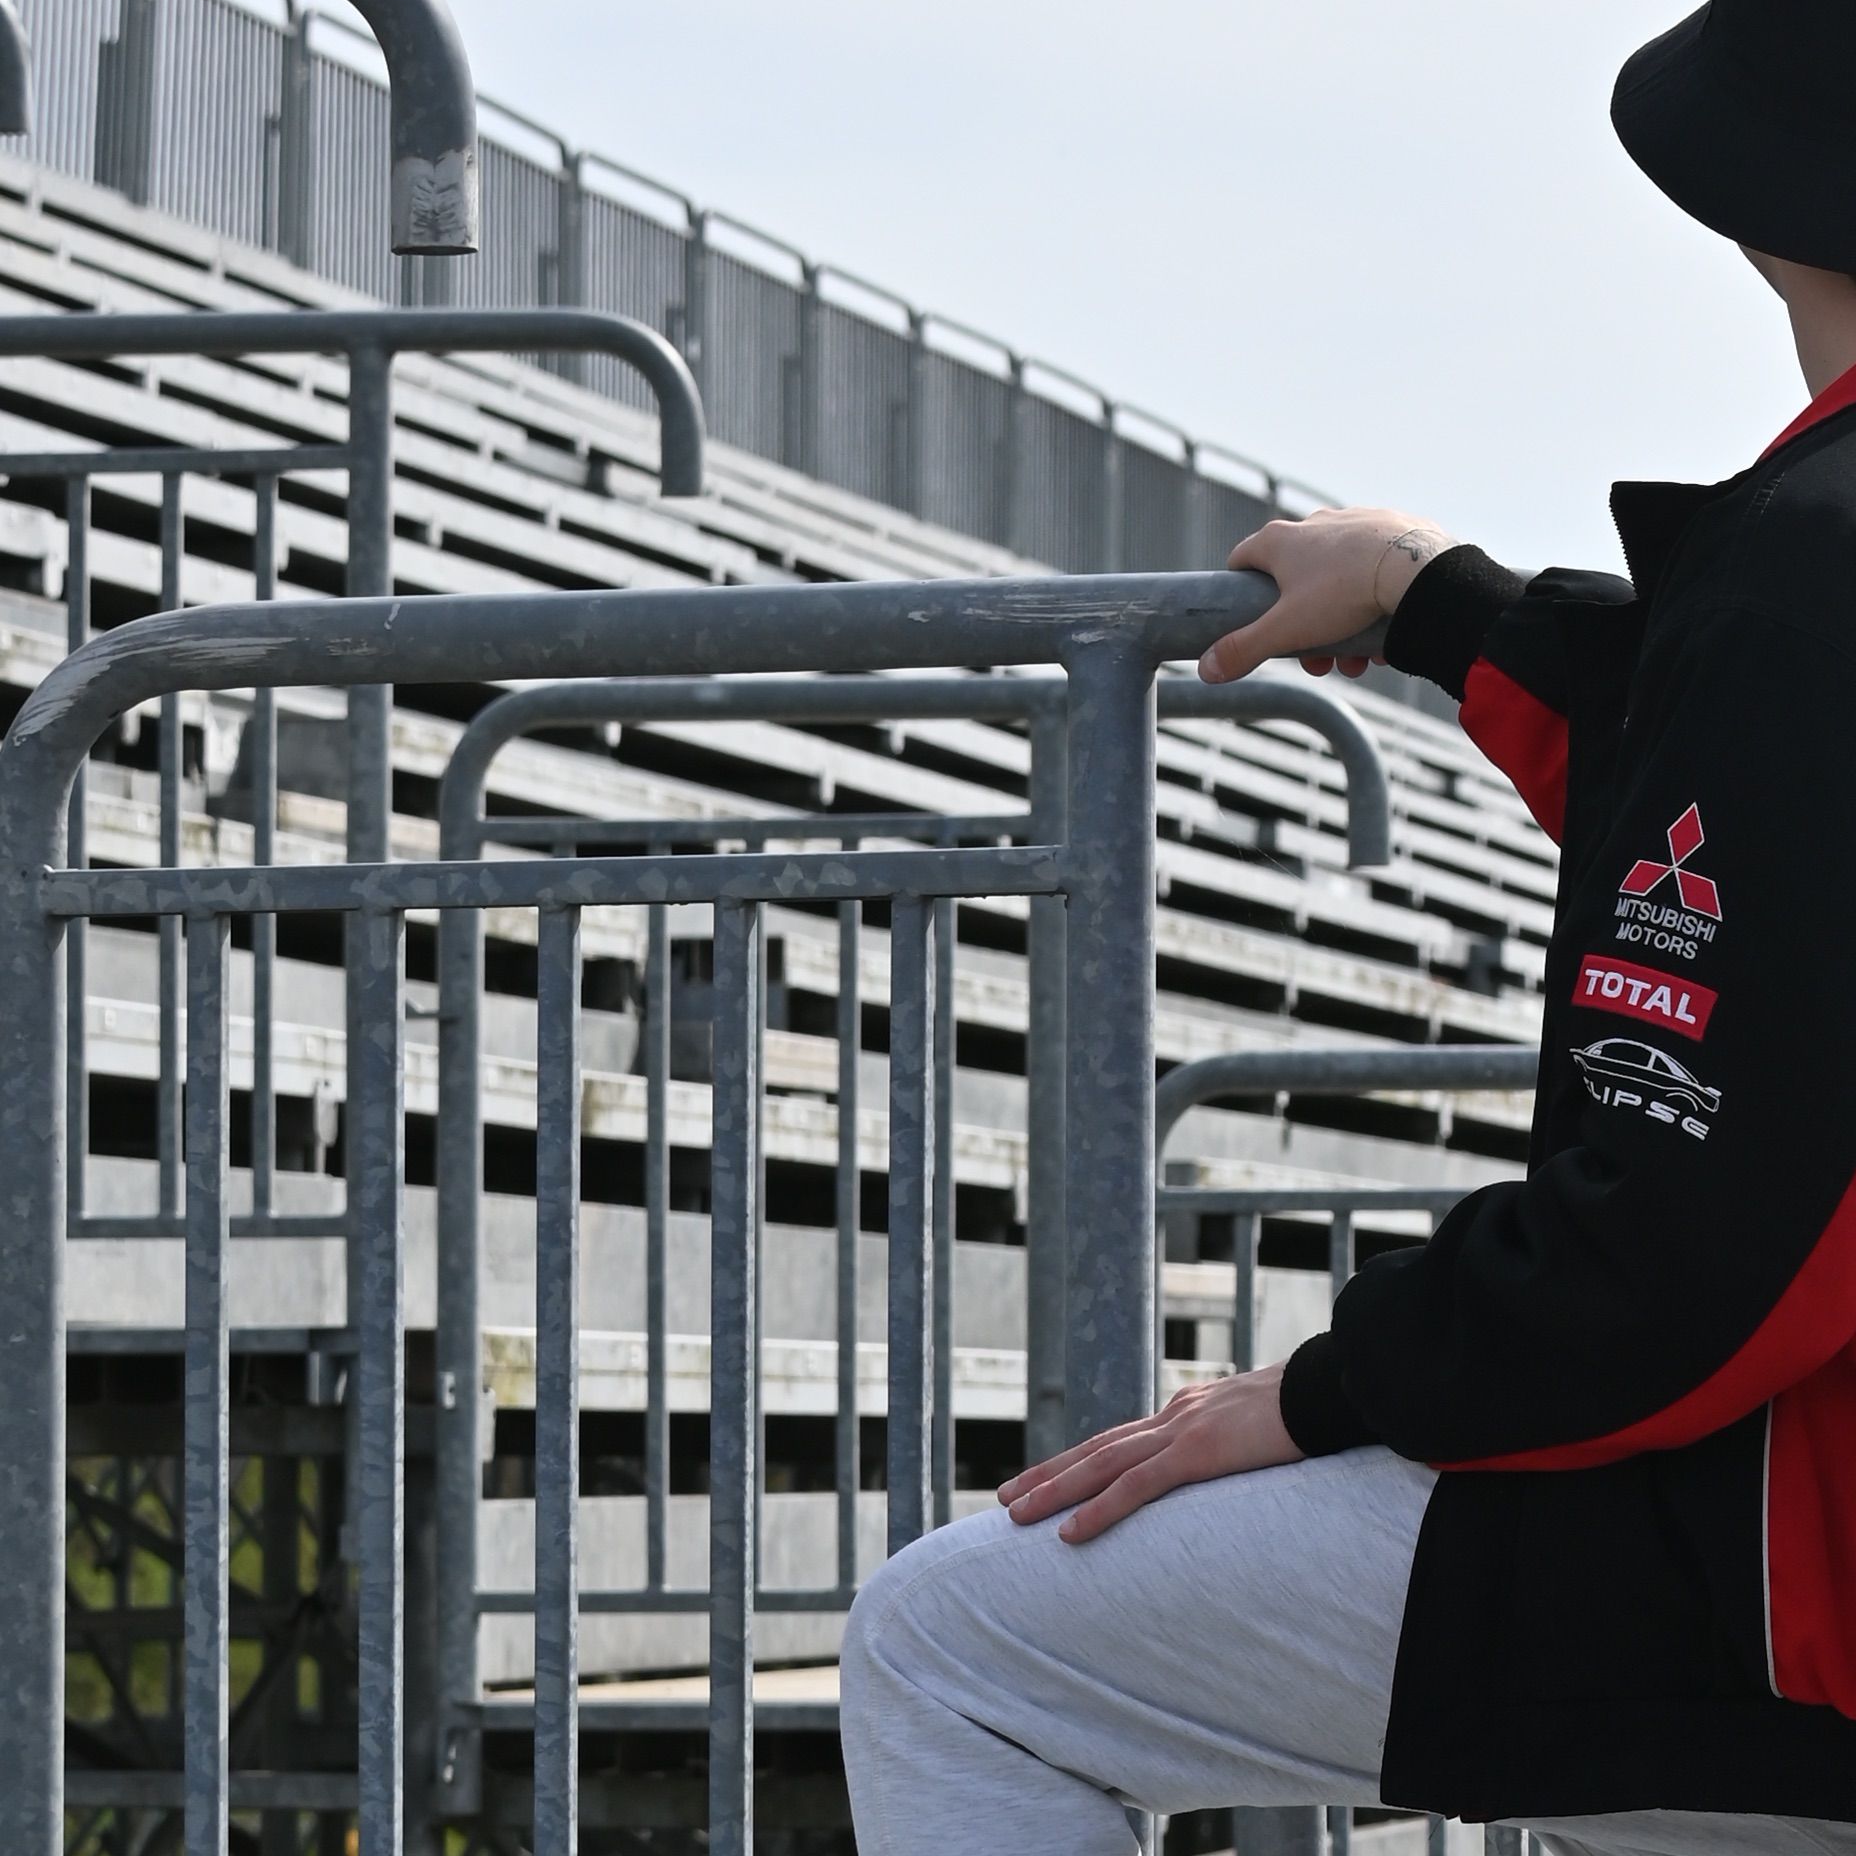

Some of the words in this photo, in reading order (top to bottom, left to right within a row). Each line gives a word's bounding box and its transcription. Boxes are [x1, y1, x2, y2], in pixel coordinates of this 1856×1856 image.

[1614, 897, 1717, 943] MITSUBISHI
[1615, 922, 1699, 960] MOTORS
[1585, 969, 1696, 1025] TOTAL
